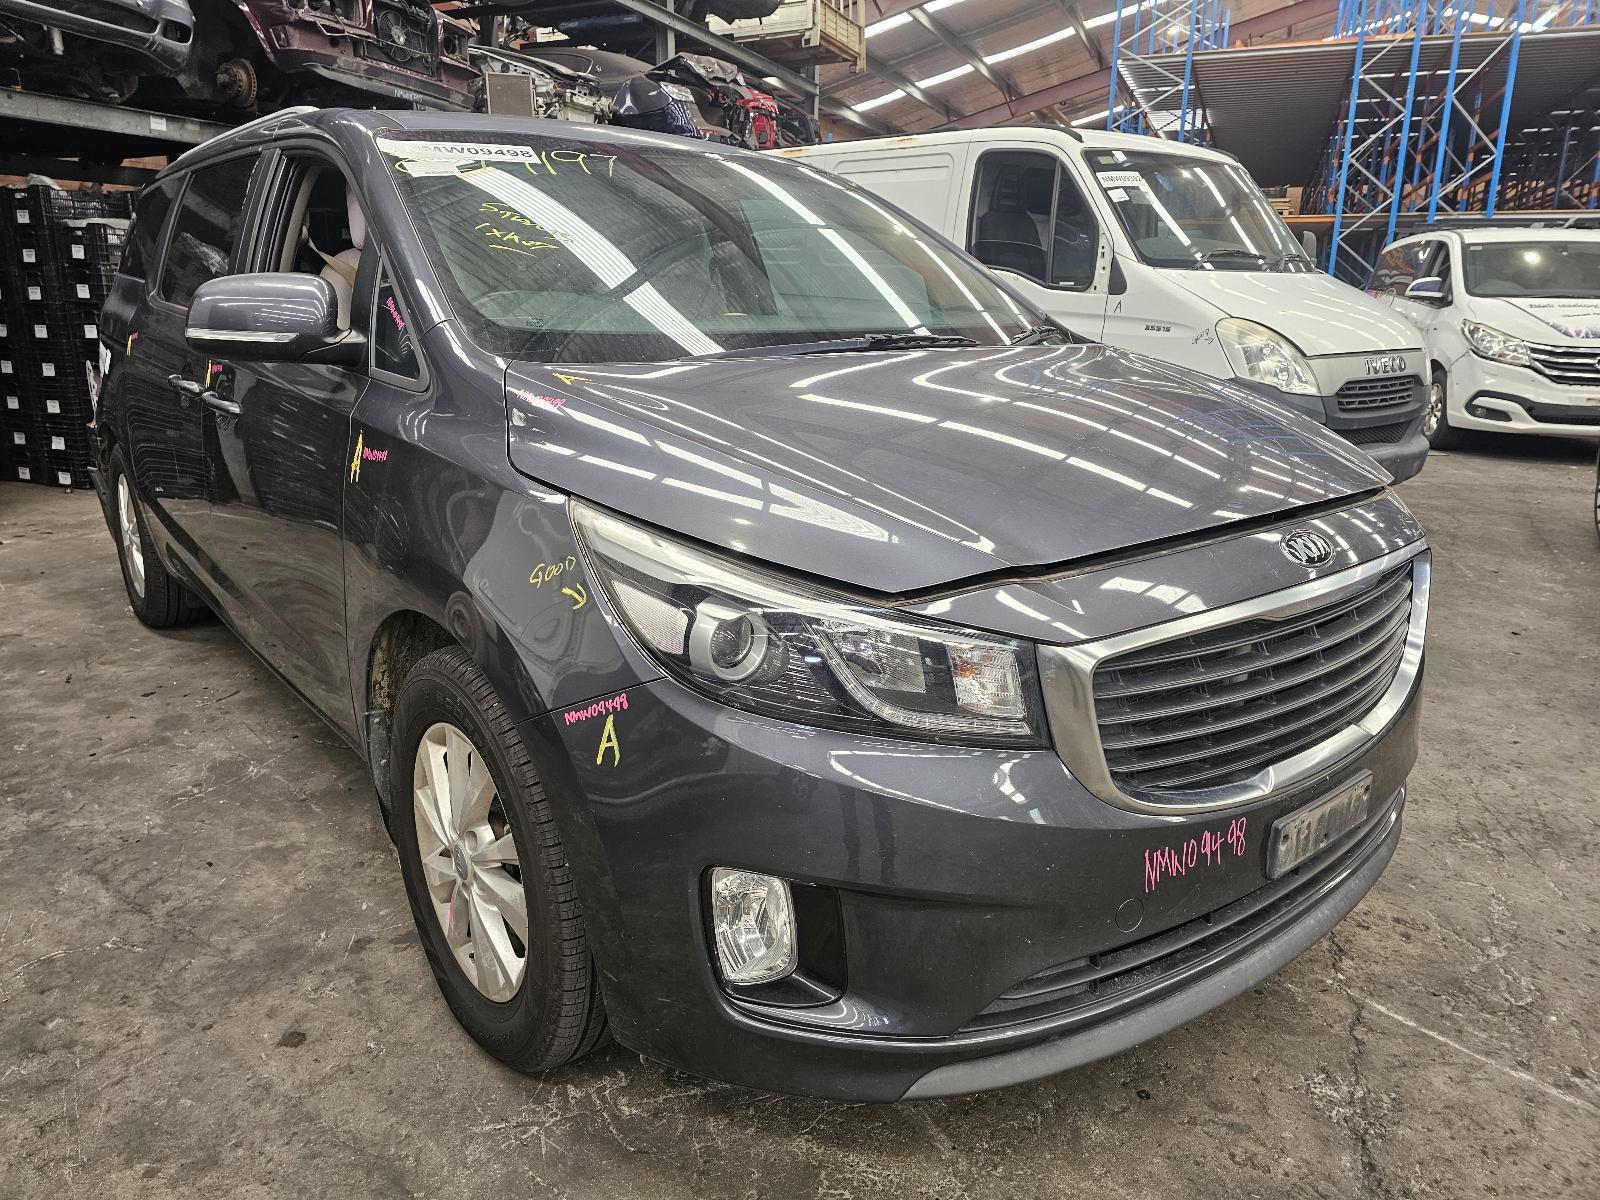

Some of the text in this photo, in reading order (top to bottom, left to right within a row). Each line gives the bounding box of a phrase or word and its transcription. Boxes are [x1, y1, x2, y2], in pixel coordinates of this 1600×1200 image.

[1363, 355, 1407, 376] IVECO
[1283, 532, 1333, 564] KIA
[529, 555, 576, 589] GOOD
[596, 713, 621, 768] A
